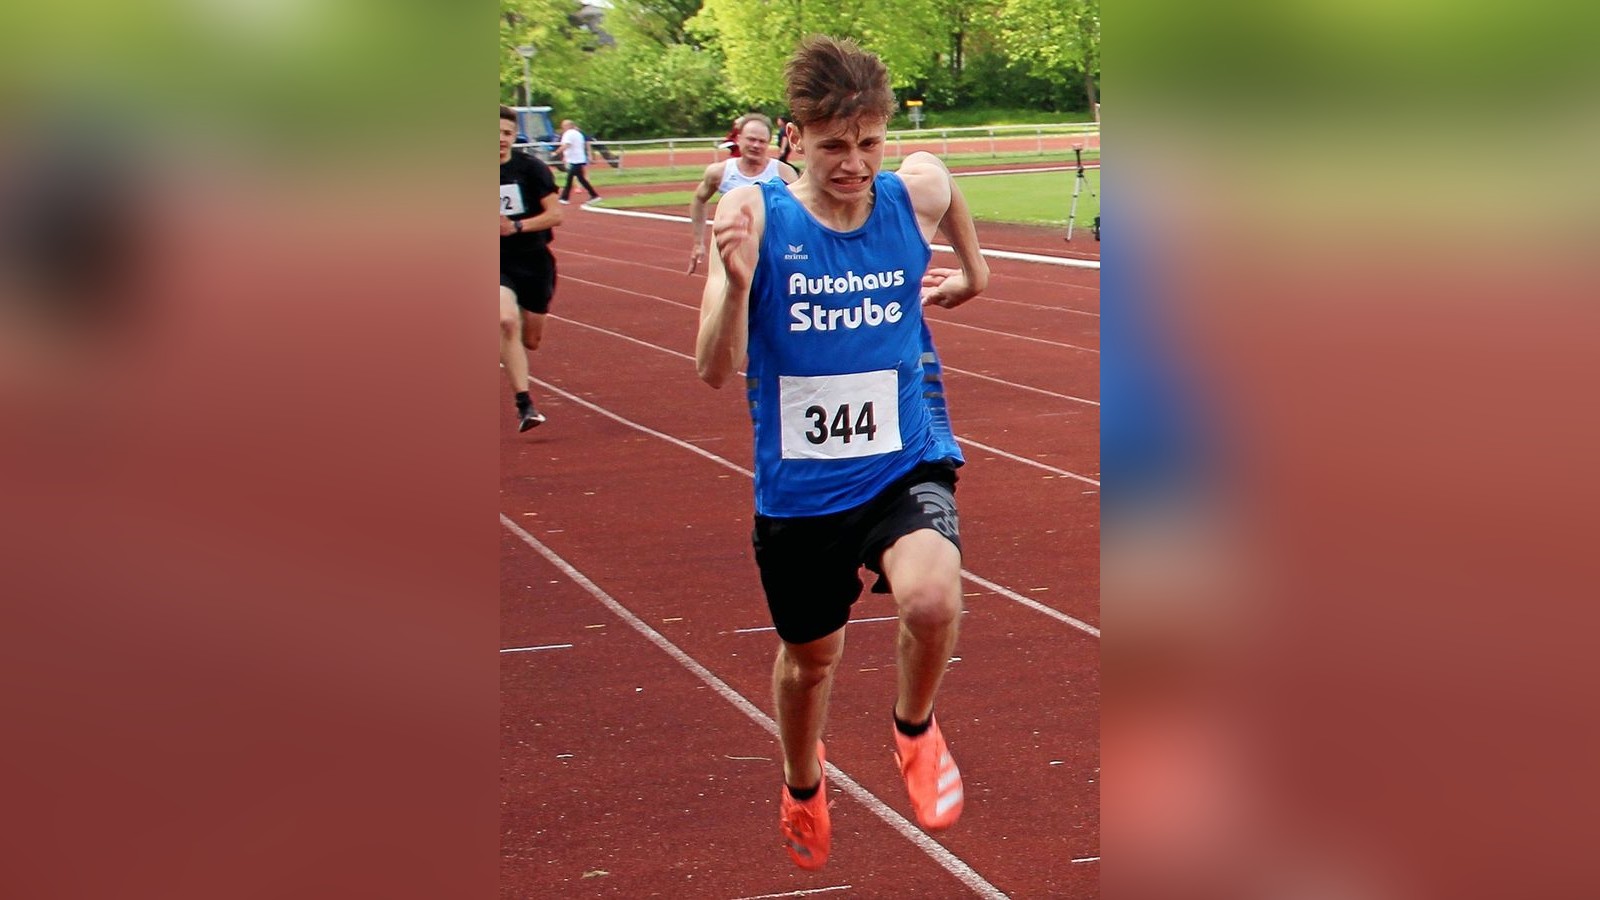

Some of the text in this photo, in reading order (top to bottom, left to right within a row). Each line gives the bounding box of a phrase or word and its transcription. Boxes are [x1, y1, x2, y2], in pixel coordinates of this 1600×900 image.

[789, 269, 905, 295] Autohaus
[790, 297, 903, 331] Strube
[805, 401, 877, 445] 344
